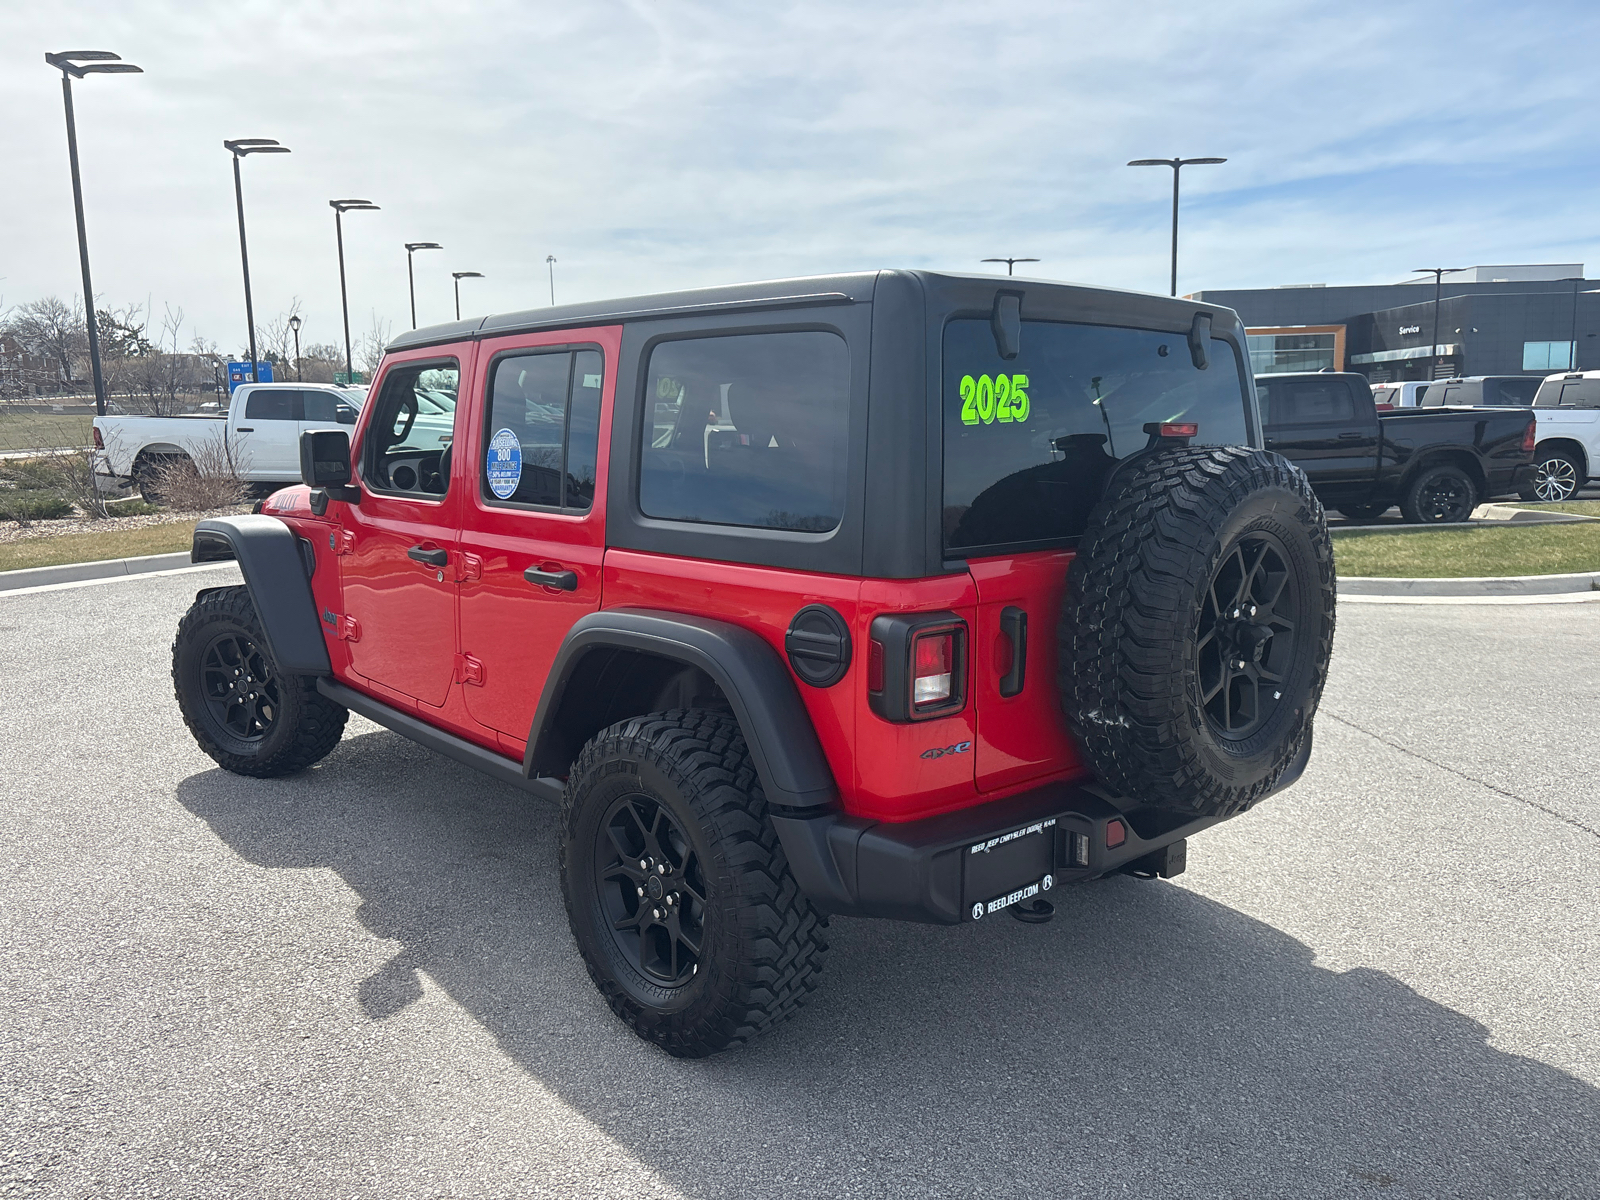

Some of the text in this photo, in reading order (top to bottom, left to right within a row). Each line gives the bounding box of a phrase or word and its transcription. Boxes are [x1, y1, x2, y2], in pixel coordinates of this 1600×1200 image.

[1399, 325, 1420, 335] Service
[959, 373, 1030, 425] 2025
[497, 448, 511, 461] 800
[491, 461, 517, 470] MILE RANGE
[322, 606, 337, 626] Jee
[971, 818, 1056, 854] REED JEEP CHRYSLER DODGE RAM
[987, 883, 1039, 914] REEDJEEP.COM
